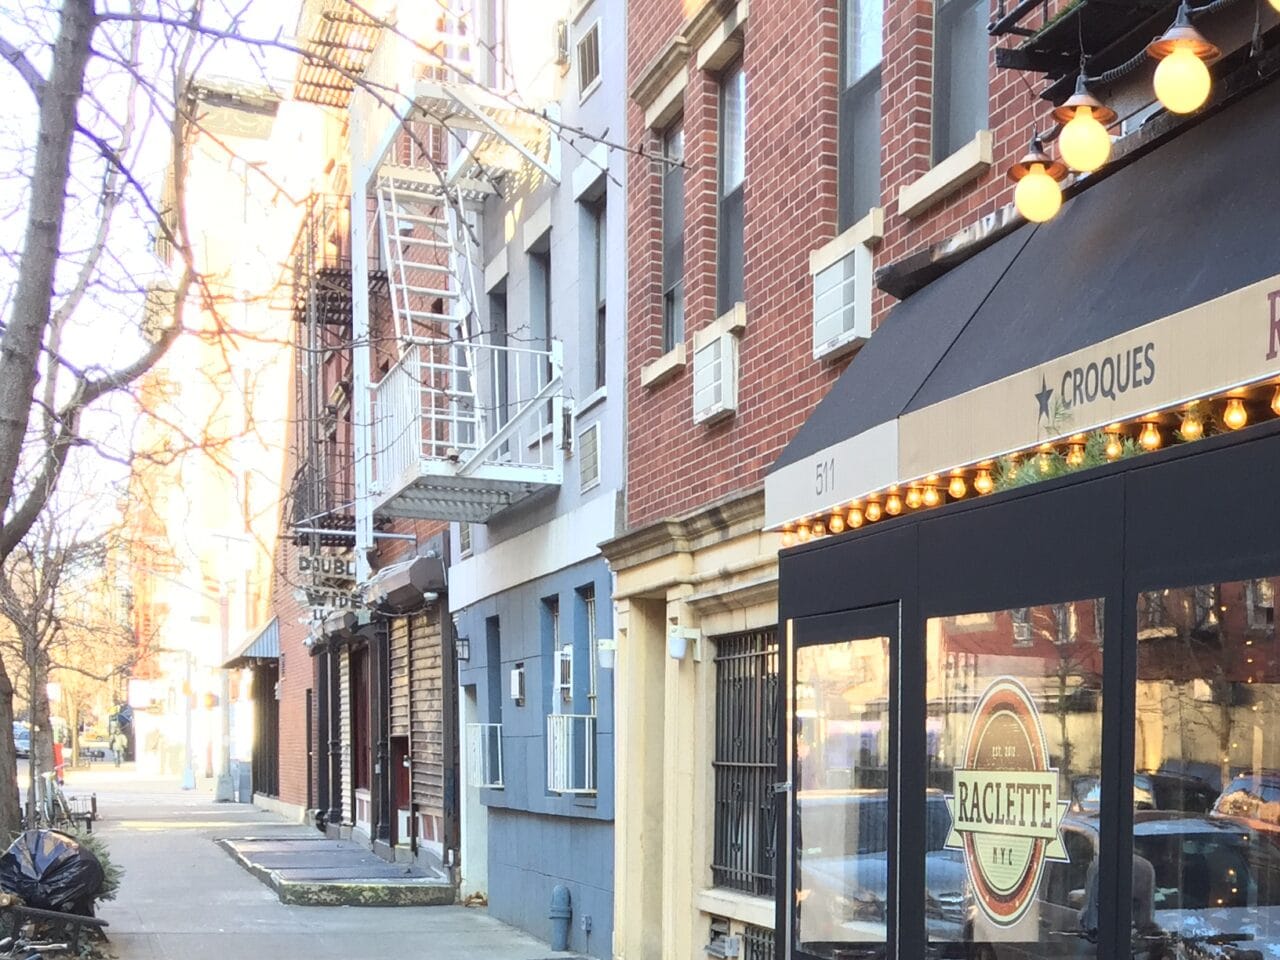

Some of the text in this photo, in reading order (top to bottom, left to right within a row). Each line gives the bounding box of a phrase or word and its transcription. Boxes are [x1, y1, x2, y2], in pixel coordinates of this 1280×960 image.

[1060, 342, 1156, 409] CROQUES
[815, 457, 835, 496] 511
[299, 556, 357, 576] DOUBL
[958, 781, 1052, 828] RACLETTE
[992, 847, 1013, 866] NYC
